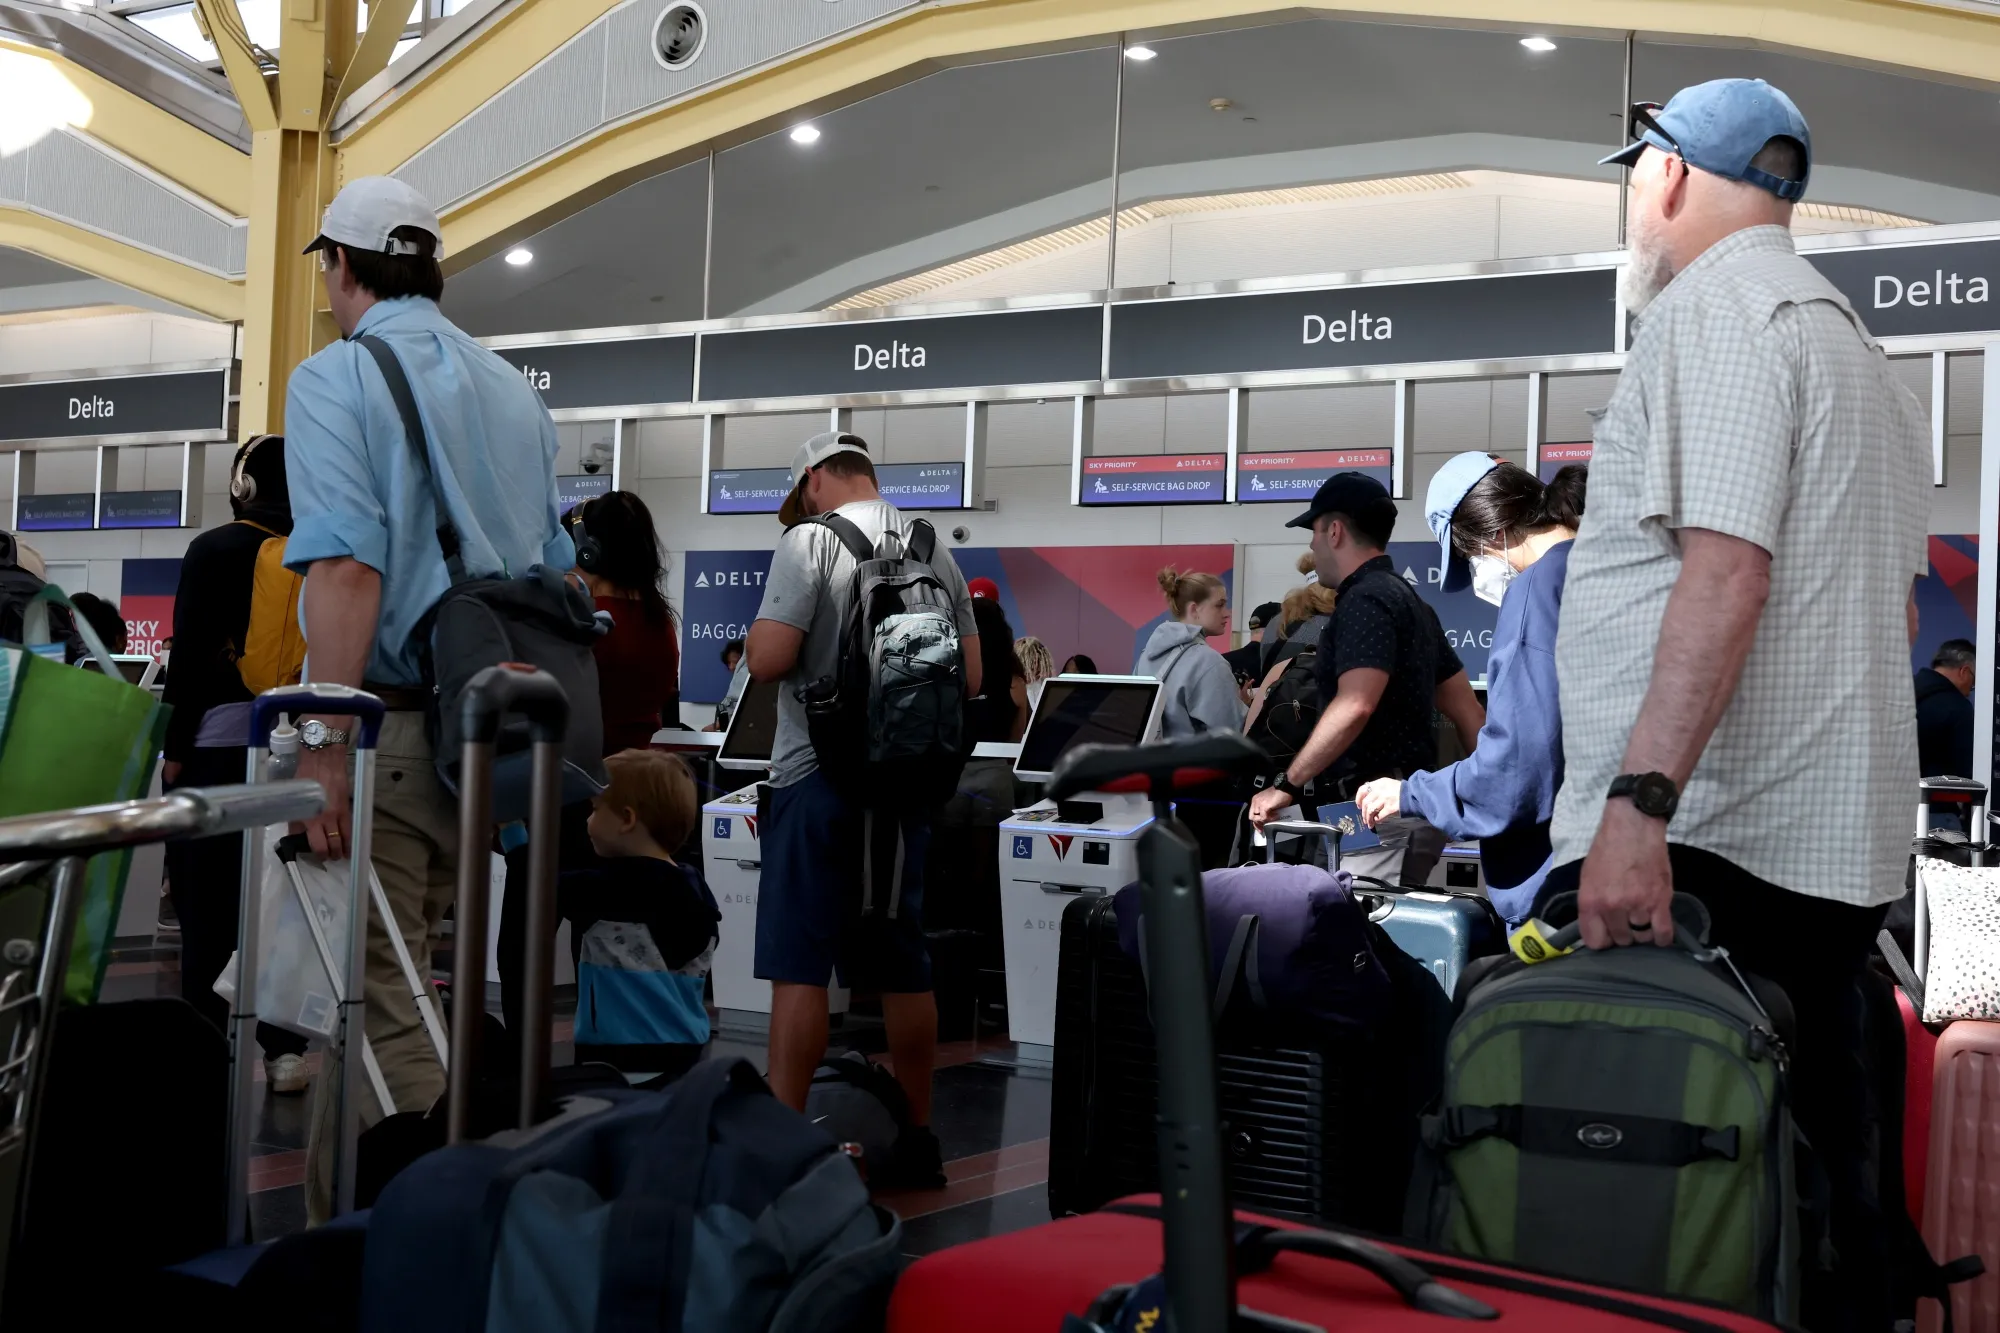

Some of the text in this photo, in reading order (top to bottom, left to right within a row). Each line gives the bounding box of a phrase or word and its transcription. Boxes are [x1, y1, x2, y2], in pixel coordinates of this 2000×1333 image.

[1874, 269, 1989, 309] Delta
[1303, 309, 1392, 344] Delta
[854, 340, 926, 371] Delta
[523, 365, 551, 390] lta
[68, 394, 114, 419] Delta
[734, 489, 778, 498] SELF-SERVICE
[878, 484, 950, 494] -SERVICE BAG DROP
[1111, 481, 1211, 492] SELF-SERVICE BAG DROP
[715, 571, 765, 586] DELT
[125, 620, 160, 637] SKY
[692, 623, 748, 639] BAGGA
[124, 639, 163, 657] PRIO
